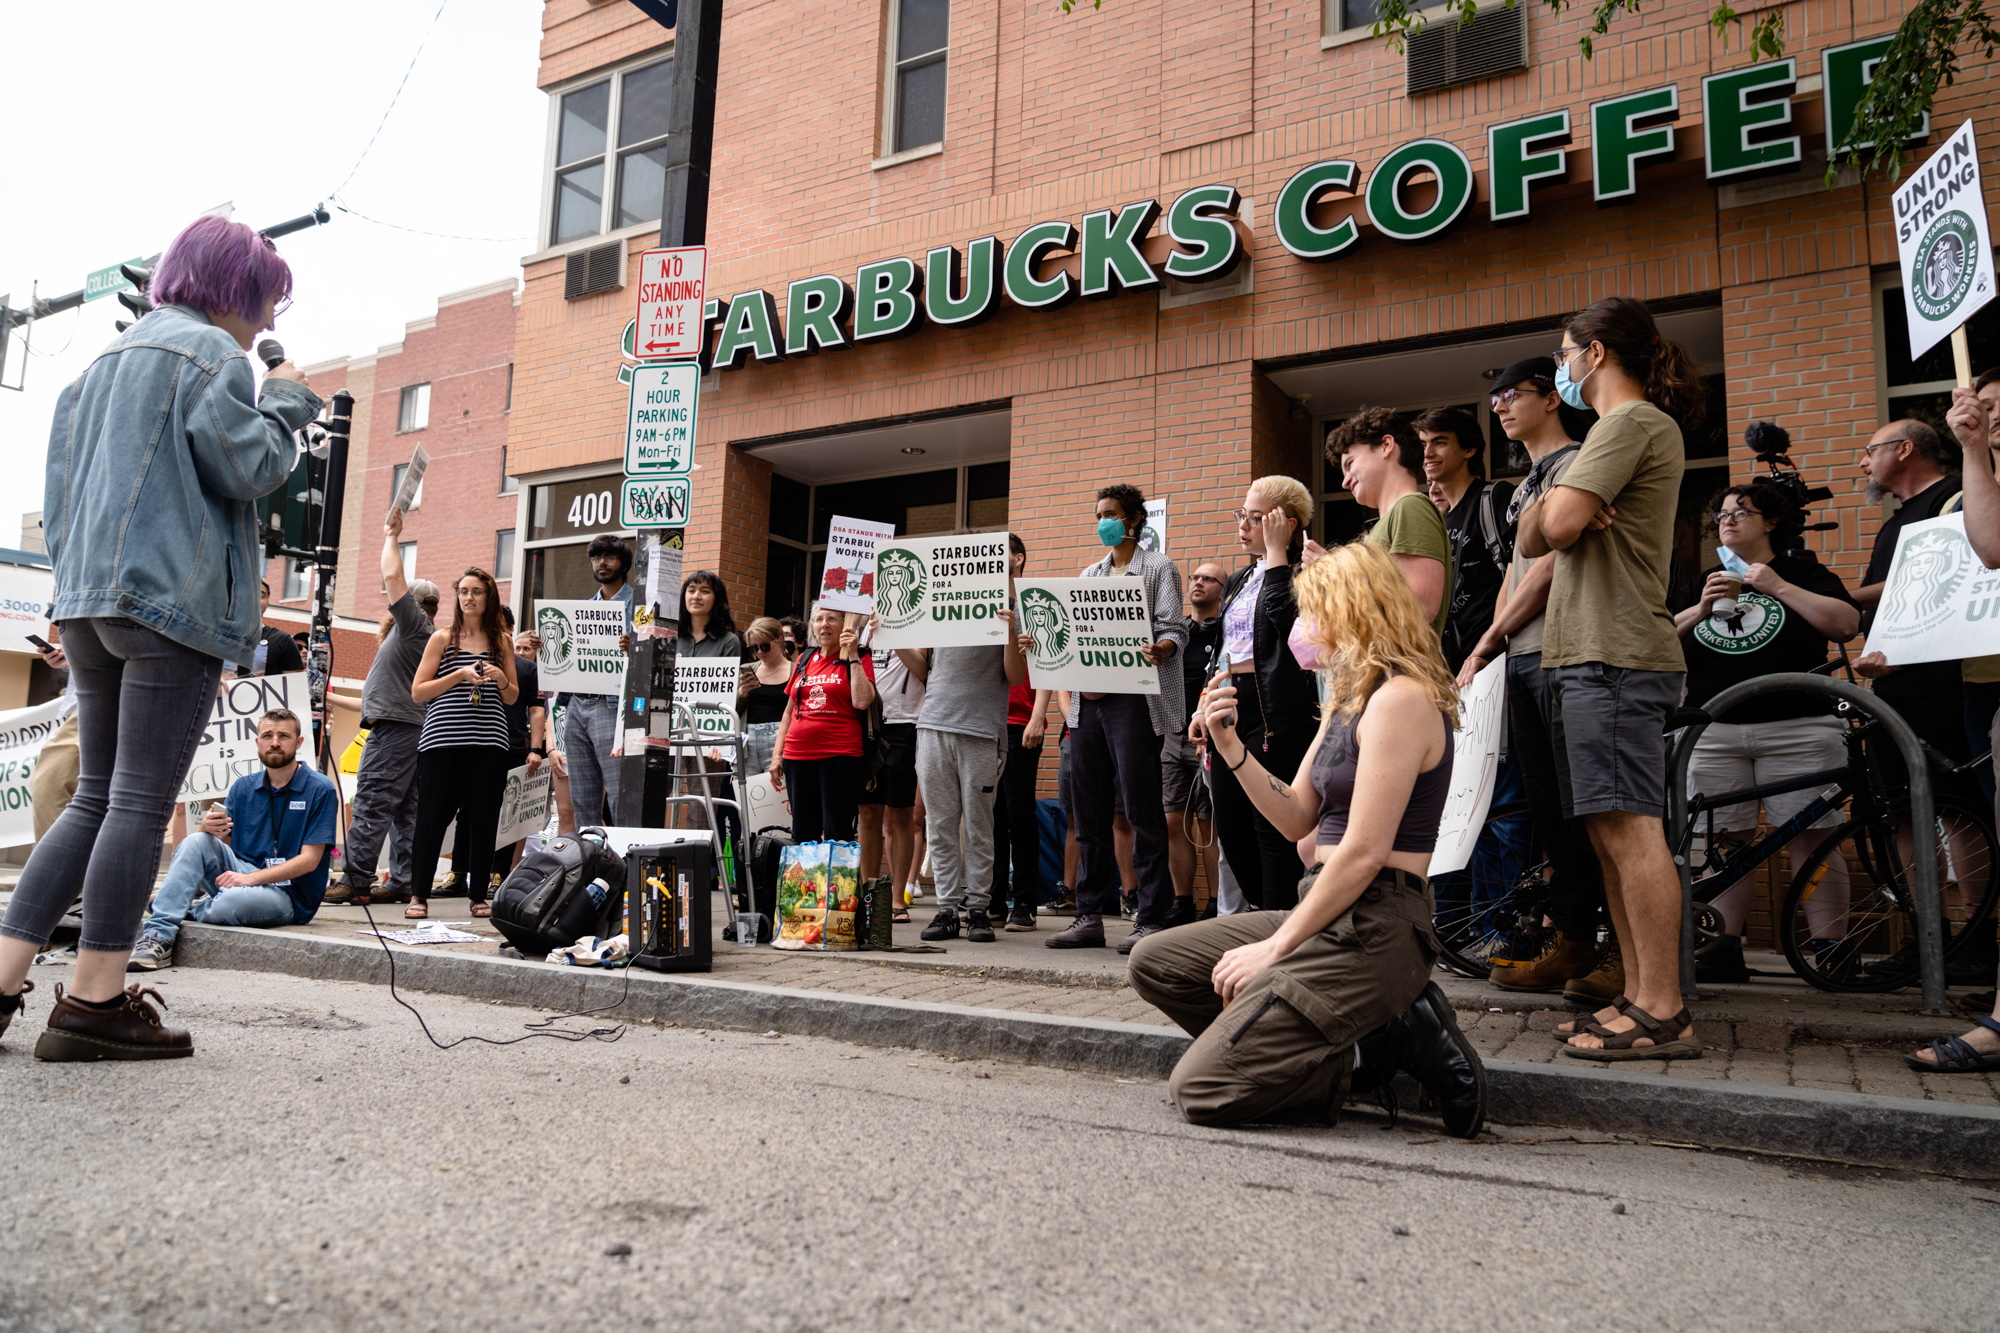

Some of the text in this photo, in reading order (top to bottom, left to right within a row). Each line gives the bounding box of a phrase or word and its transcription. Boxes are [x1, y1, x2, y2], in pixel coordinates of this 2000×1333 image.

[1897, 133, 1970, 219] UNION
[1899, 162, 1975, 244] STRONG
[1915, 214, 1968, 269] DSA STANDS WITH
[661, 257, 683, 278] NO
[616, 184, 1240, 385] ARBUCKS
[1913, 284, 1951, 315] STARBUCKS
[1951, 240, 1977, 304] WORKERS
[641, 279, 702, 303] STANDING
[655, 304, 684, 320] ANY
[650, 321, 685, 337] TIME
[661, 371, 669, 385] 2
[646, 389, 680, 404] HOUR
[637, 408, 687, 423] PARKING
[635, 427, 687, 442] 9AM-6PM
[638, 444, 681, 459] Mon-Fri
[665, 485, 683, 500] TO
[567, 490, 613, 528] 400
[848, 528, 873, 537] STANDS
[932, 543, 1004, 560] STARBUCKS
[932, 560, 1004, 577] CUSTOMER
[1976, 566, 1997, 575] FO
[932, 589, 1004, 602] STARBUCKS
[1070, 589, 1142, 603] STARBUCKS
[575, 610, 623, 621] STARBUCKS
[932, 602, 1004, 621] UNION
[1072, 607, 1145, 620] CUSTOMER
[1887, 606, 1950, 633] Customers demand
[576, 624, 623, 636] CUSTOMER
[1749, 612, 1779, 644] UNITED
[1898, 628, 1924, 640] support
[1925, 623, 1936, 632] the
[1937, 609, 1957, 625] union
[1698, 619, 1737, 648] WORKERS
[1077, 637, 1149, 647] STARBUCKS
[577, 647, 624, 658] STARBUCKS
[1080, 650, 1152, 668] UNION
[578, 658, 624, 674] UNION
[674, 667, 736, 678] STARBUCKS
[673, 681, 734, 693] CUSTOMER
[671, 706, 731, 715] STRBUCKS
[219, 747, 235, 758] is
[524, 765, 550, 781] SBUCKS
[523, 776, 549, 792] CUSTOMER
[520, 796, 546, 810] STARBUCKS
[518, 804, 546, 823] UNION
